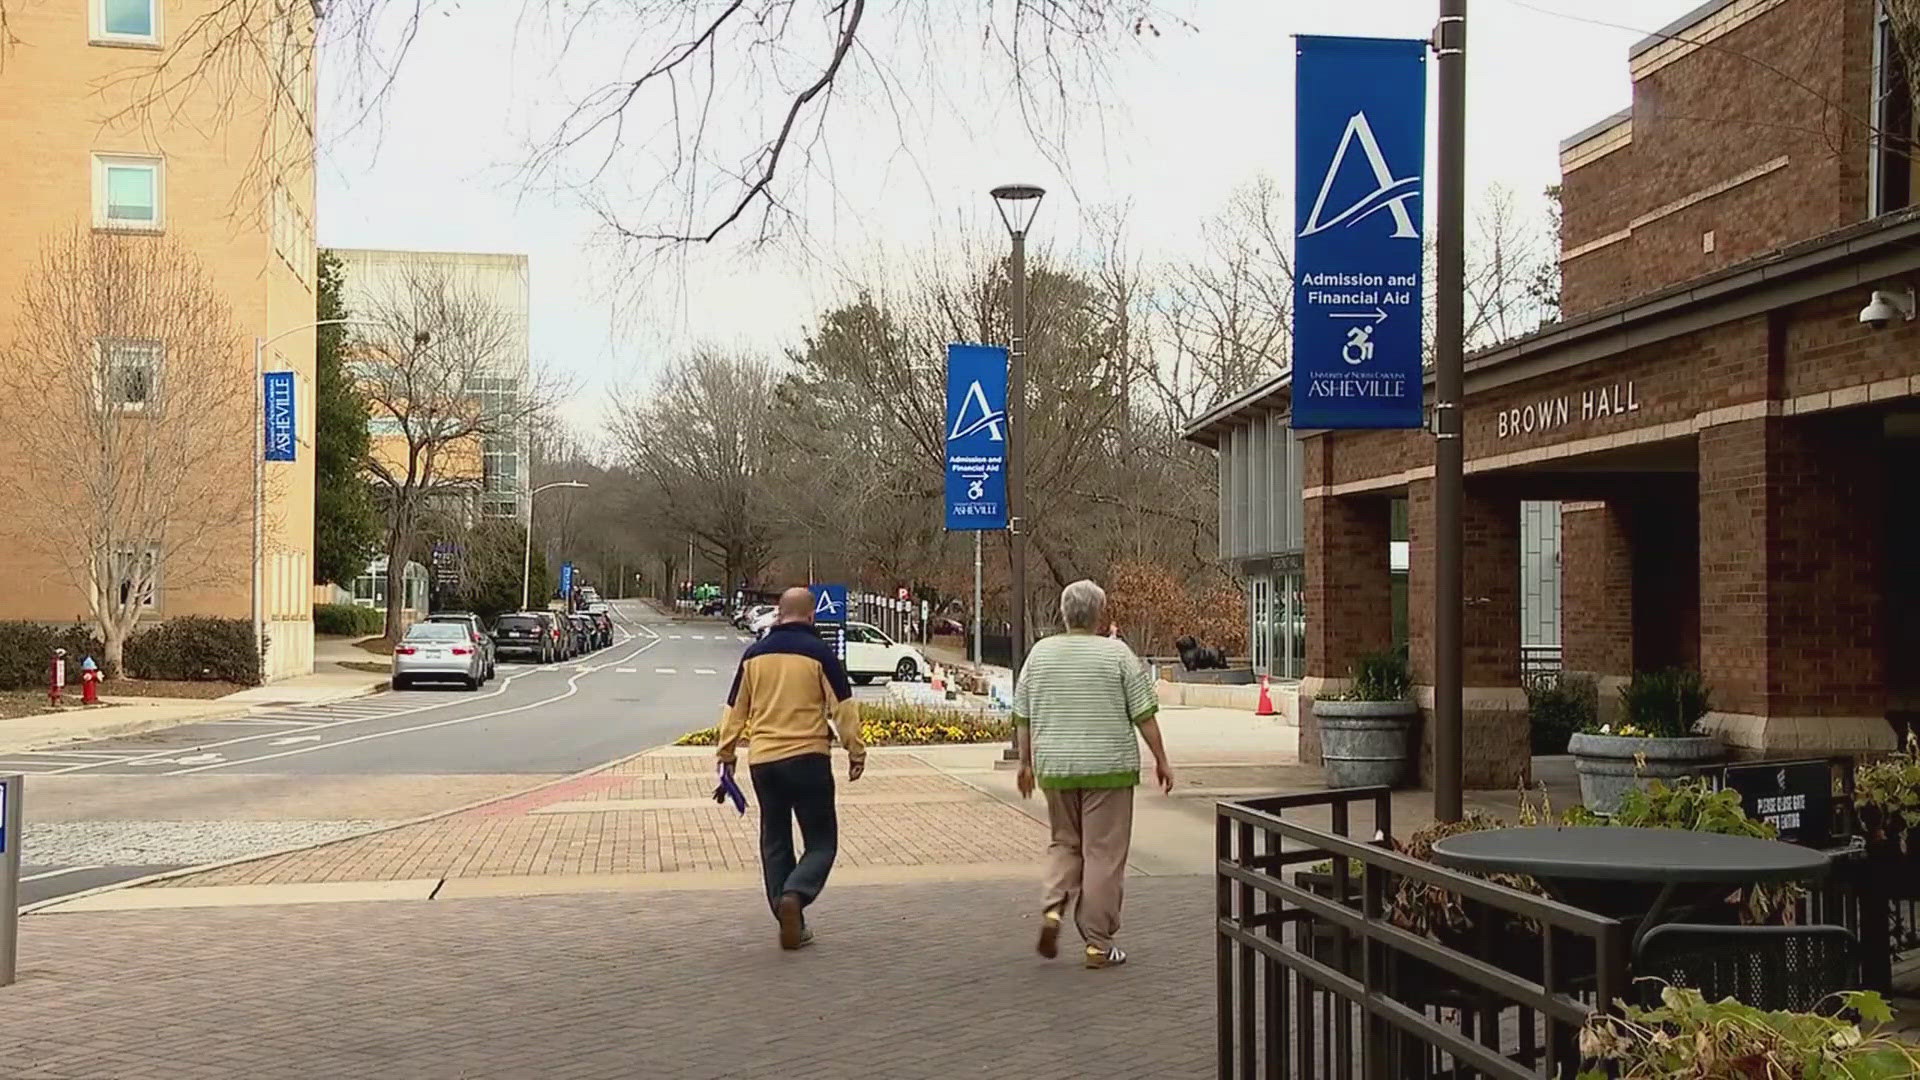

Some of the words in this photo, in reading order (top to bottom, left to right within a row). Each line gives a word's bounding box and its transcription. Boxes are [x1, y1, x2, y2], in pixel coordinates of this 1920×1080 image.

[1301, 272, 1383, 286] Admission
[1387, 272, 1416, 286] and
[1308, 291, 1378, 304] Financial
[1383, 291, 1410, 304] Aid
[1308, 380, 1405, 397] ASHEVILLE
[275, 378, 291, 453] ASHEVILLE
[1498, 395, 1569, 438] BROWN
[1582, 381, 1639, 421] HALL
[952, 464, 985, 472] Financial
[986, 464, 999, 472] Aid
